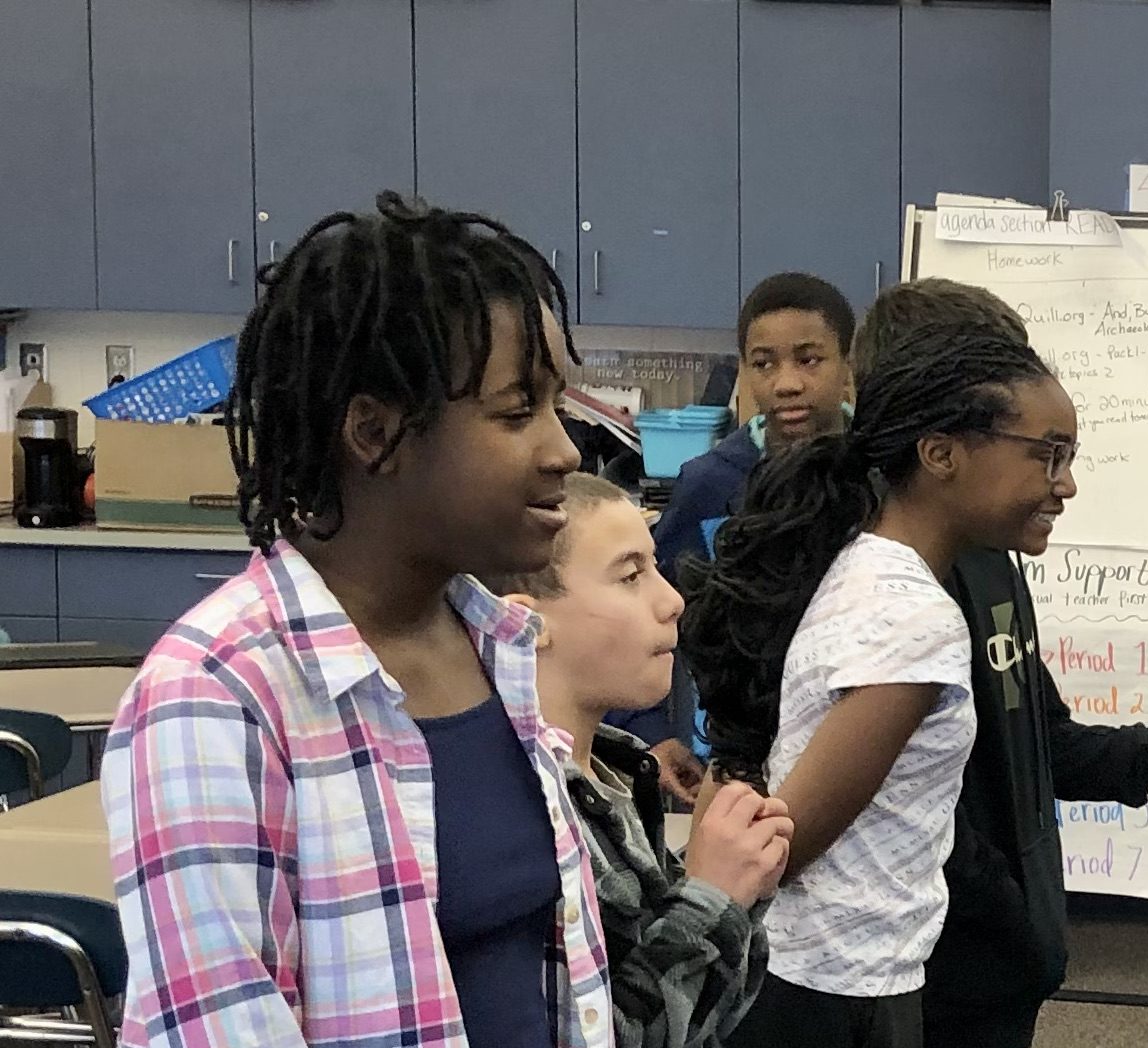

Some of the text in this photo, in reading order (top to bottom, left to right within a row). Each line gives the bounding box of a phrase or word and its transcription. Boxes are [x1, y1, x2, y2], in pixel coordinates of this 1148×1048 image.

[940, 211, 995, 237] agenda
[1000, 212, 1050, 233] section
[987, 249, 1063, 271] Homework
[627, 356, 703, 373] something
[597, 368, 624, 379] new
[1099, 394, 1119, 411] 20
[1097, 451, 1131, 464] work
[1065, 592, 1109, 606] teacher
[1059, 636, 1116, 675] Period
[1127, 845, 1143, 881] 7
